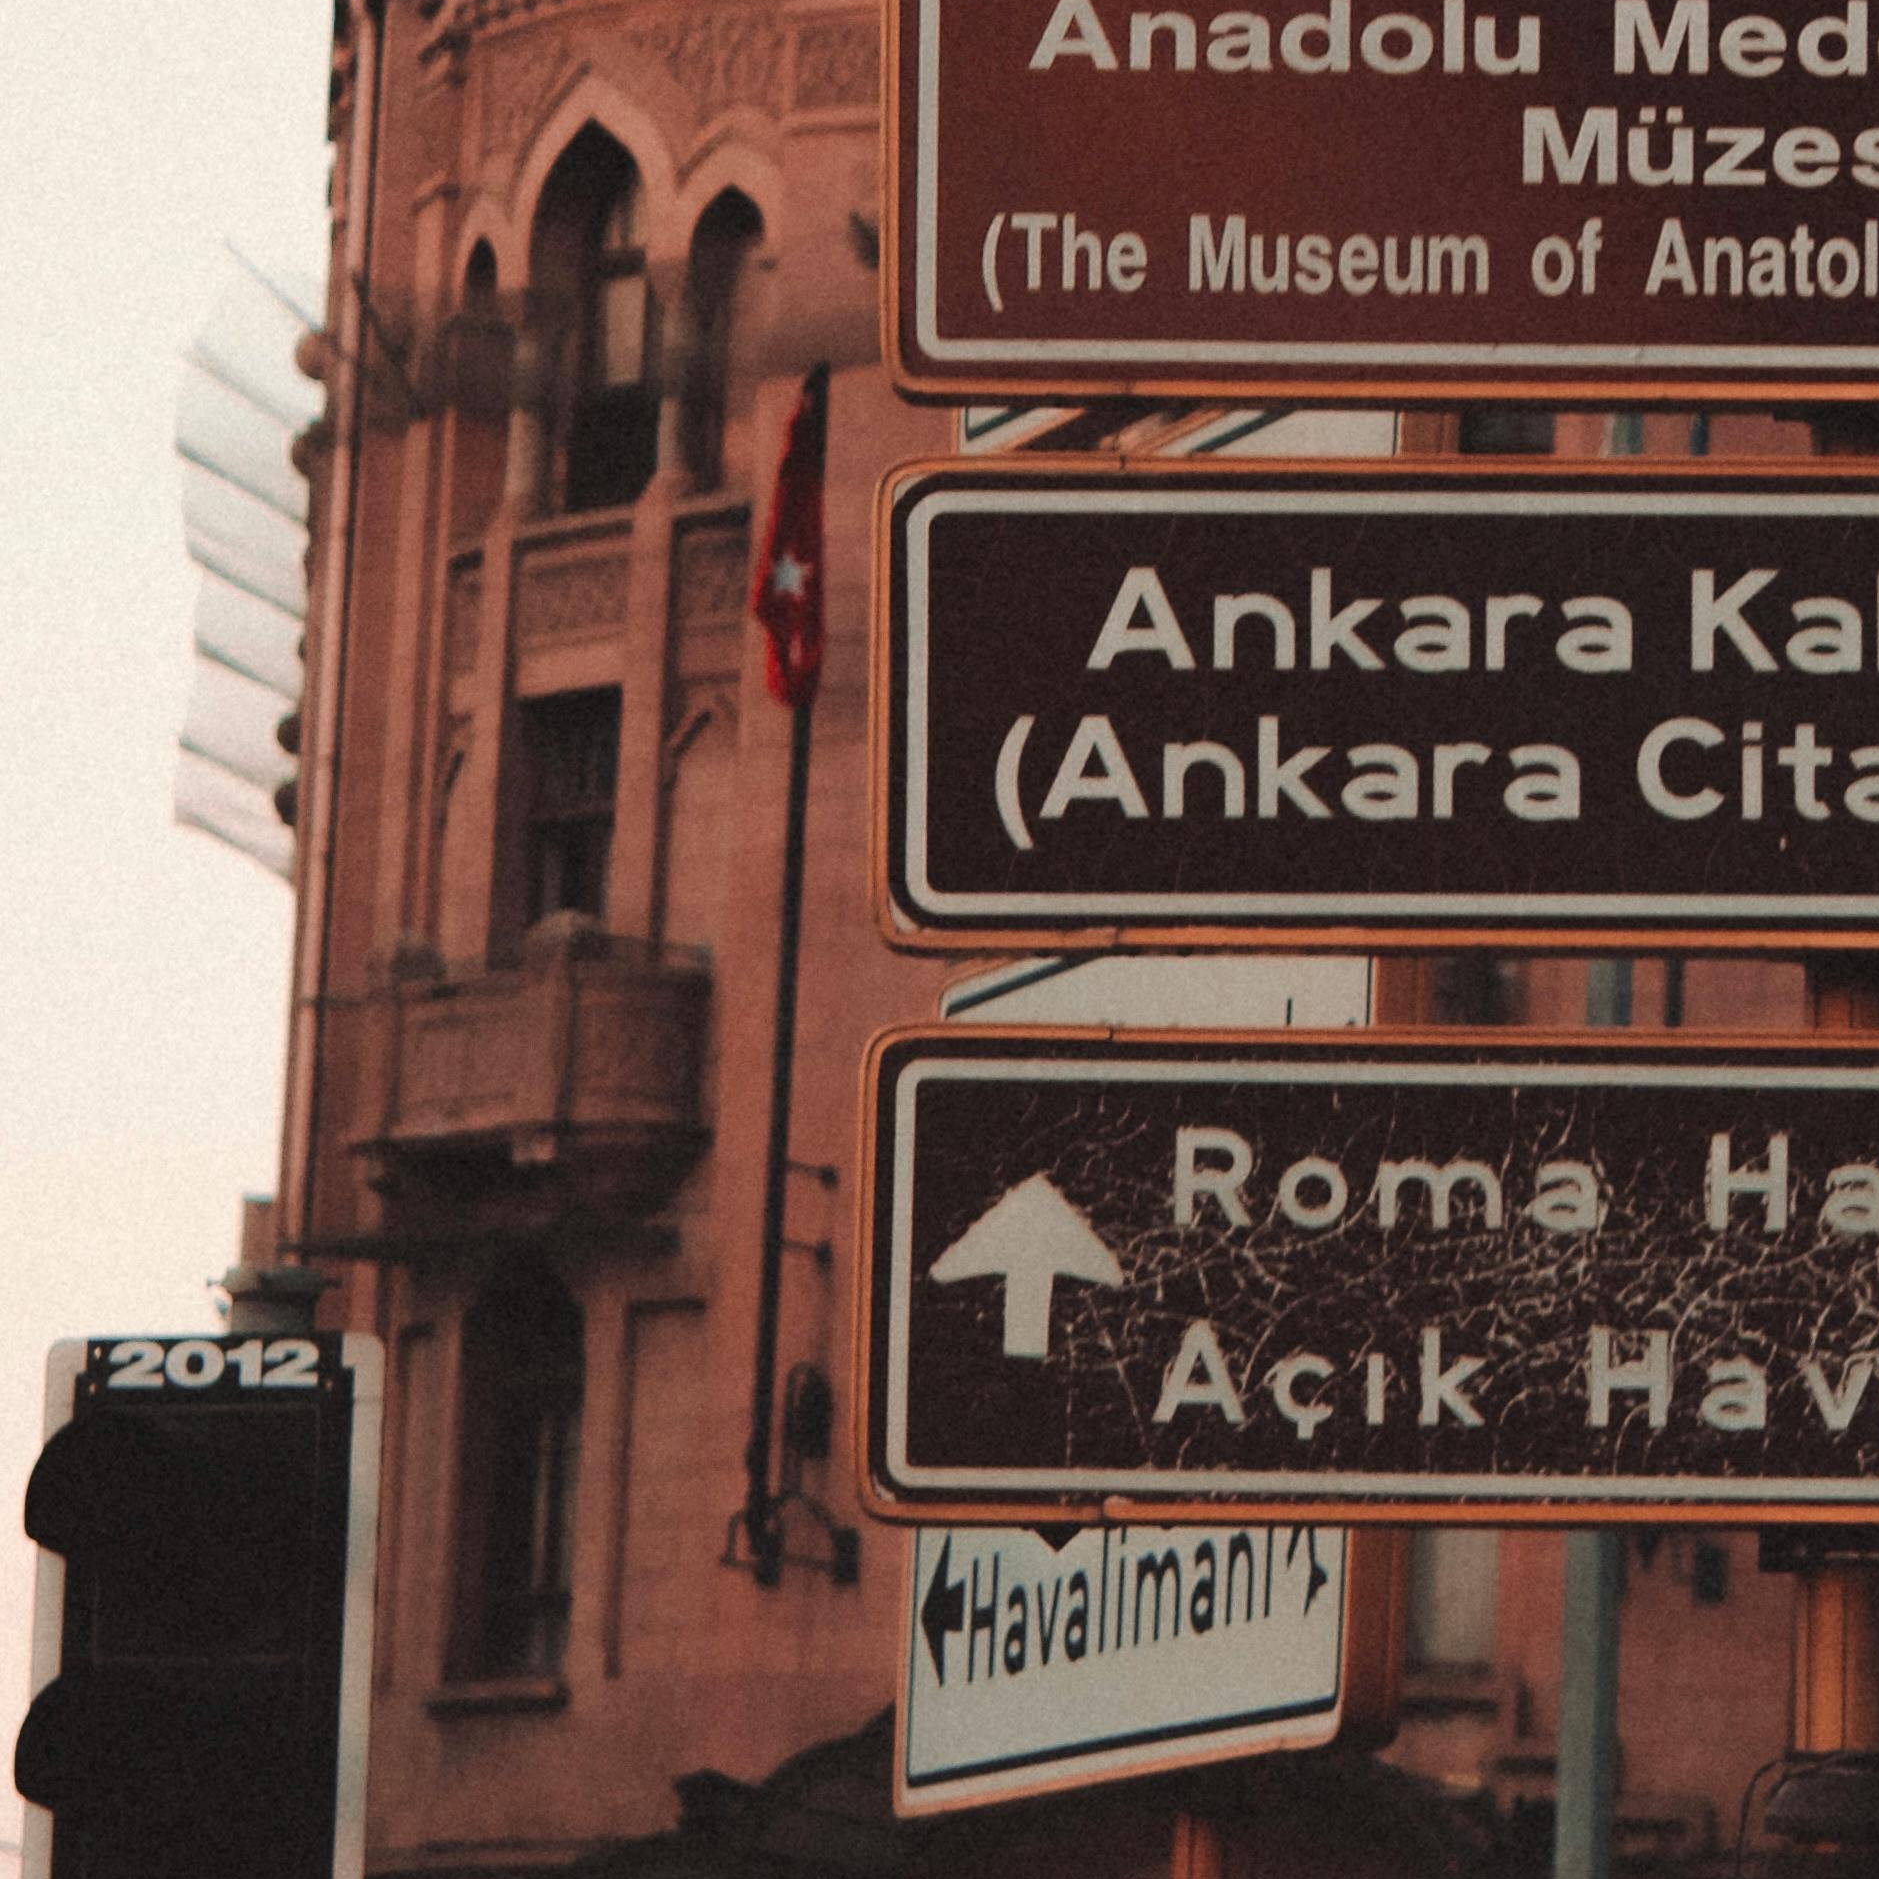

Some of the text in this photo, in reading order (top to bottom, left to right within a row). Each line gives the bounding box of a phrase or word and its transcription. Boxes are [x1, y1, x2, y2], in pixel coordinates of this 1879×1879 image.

[982, 213, 1147, 311] (The
[1189, 215, 1489, 295] Museum
[1532, 218, 1602, 296] of
[1088, 568, 1632, 672] Ankara
[995, 716, 1580, 849] (Ankara
[1172, 1126, 1606, 1233] Roma
[107, 1337, 320, 1388] 2012
[1152, 1321, 1485, 1441] Açık
